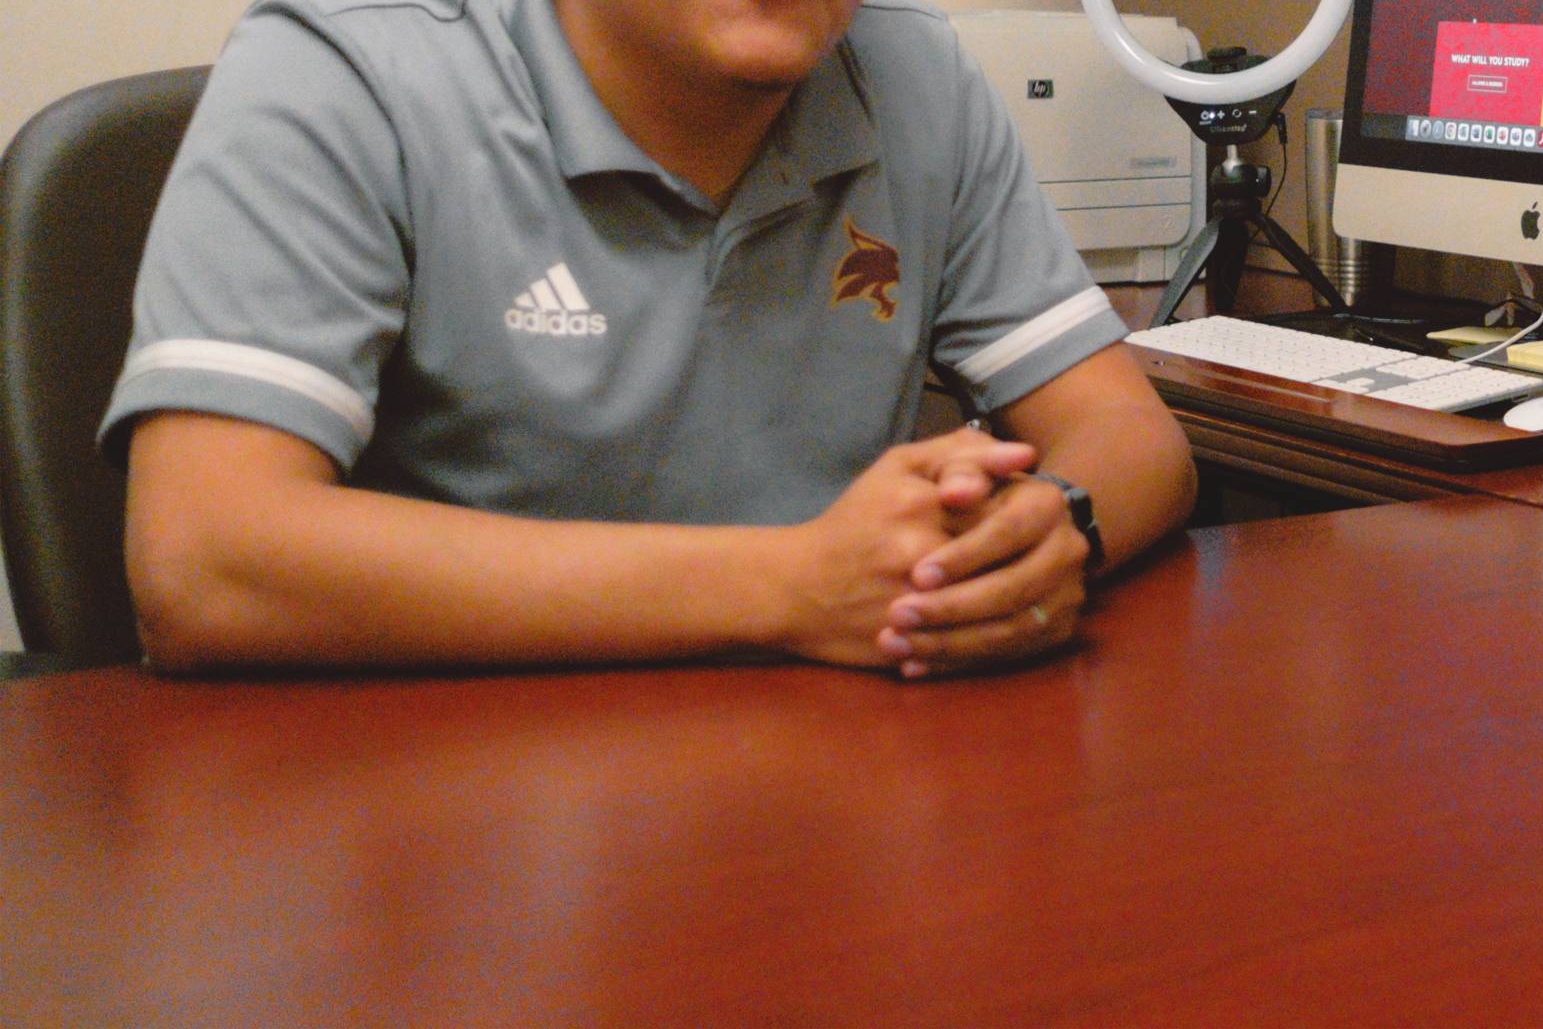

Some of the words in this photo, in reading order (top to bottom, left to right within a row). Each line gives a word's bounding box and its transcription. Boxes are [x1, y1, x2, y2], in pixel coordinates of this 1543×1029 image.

[1451, 54, 1471, 64] WHAT
[1471, 55, 1488, 65] WILL
[1488, 56, 1504, 66] YOU
[1504, 57, 1530, 68] STUDY?
[504, 309, 608, 336] adidas
